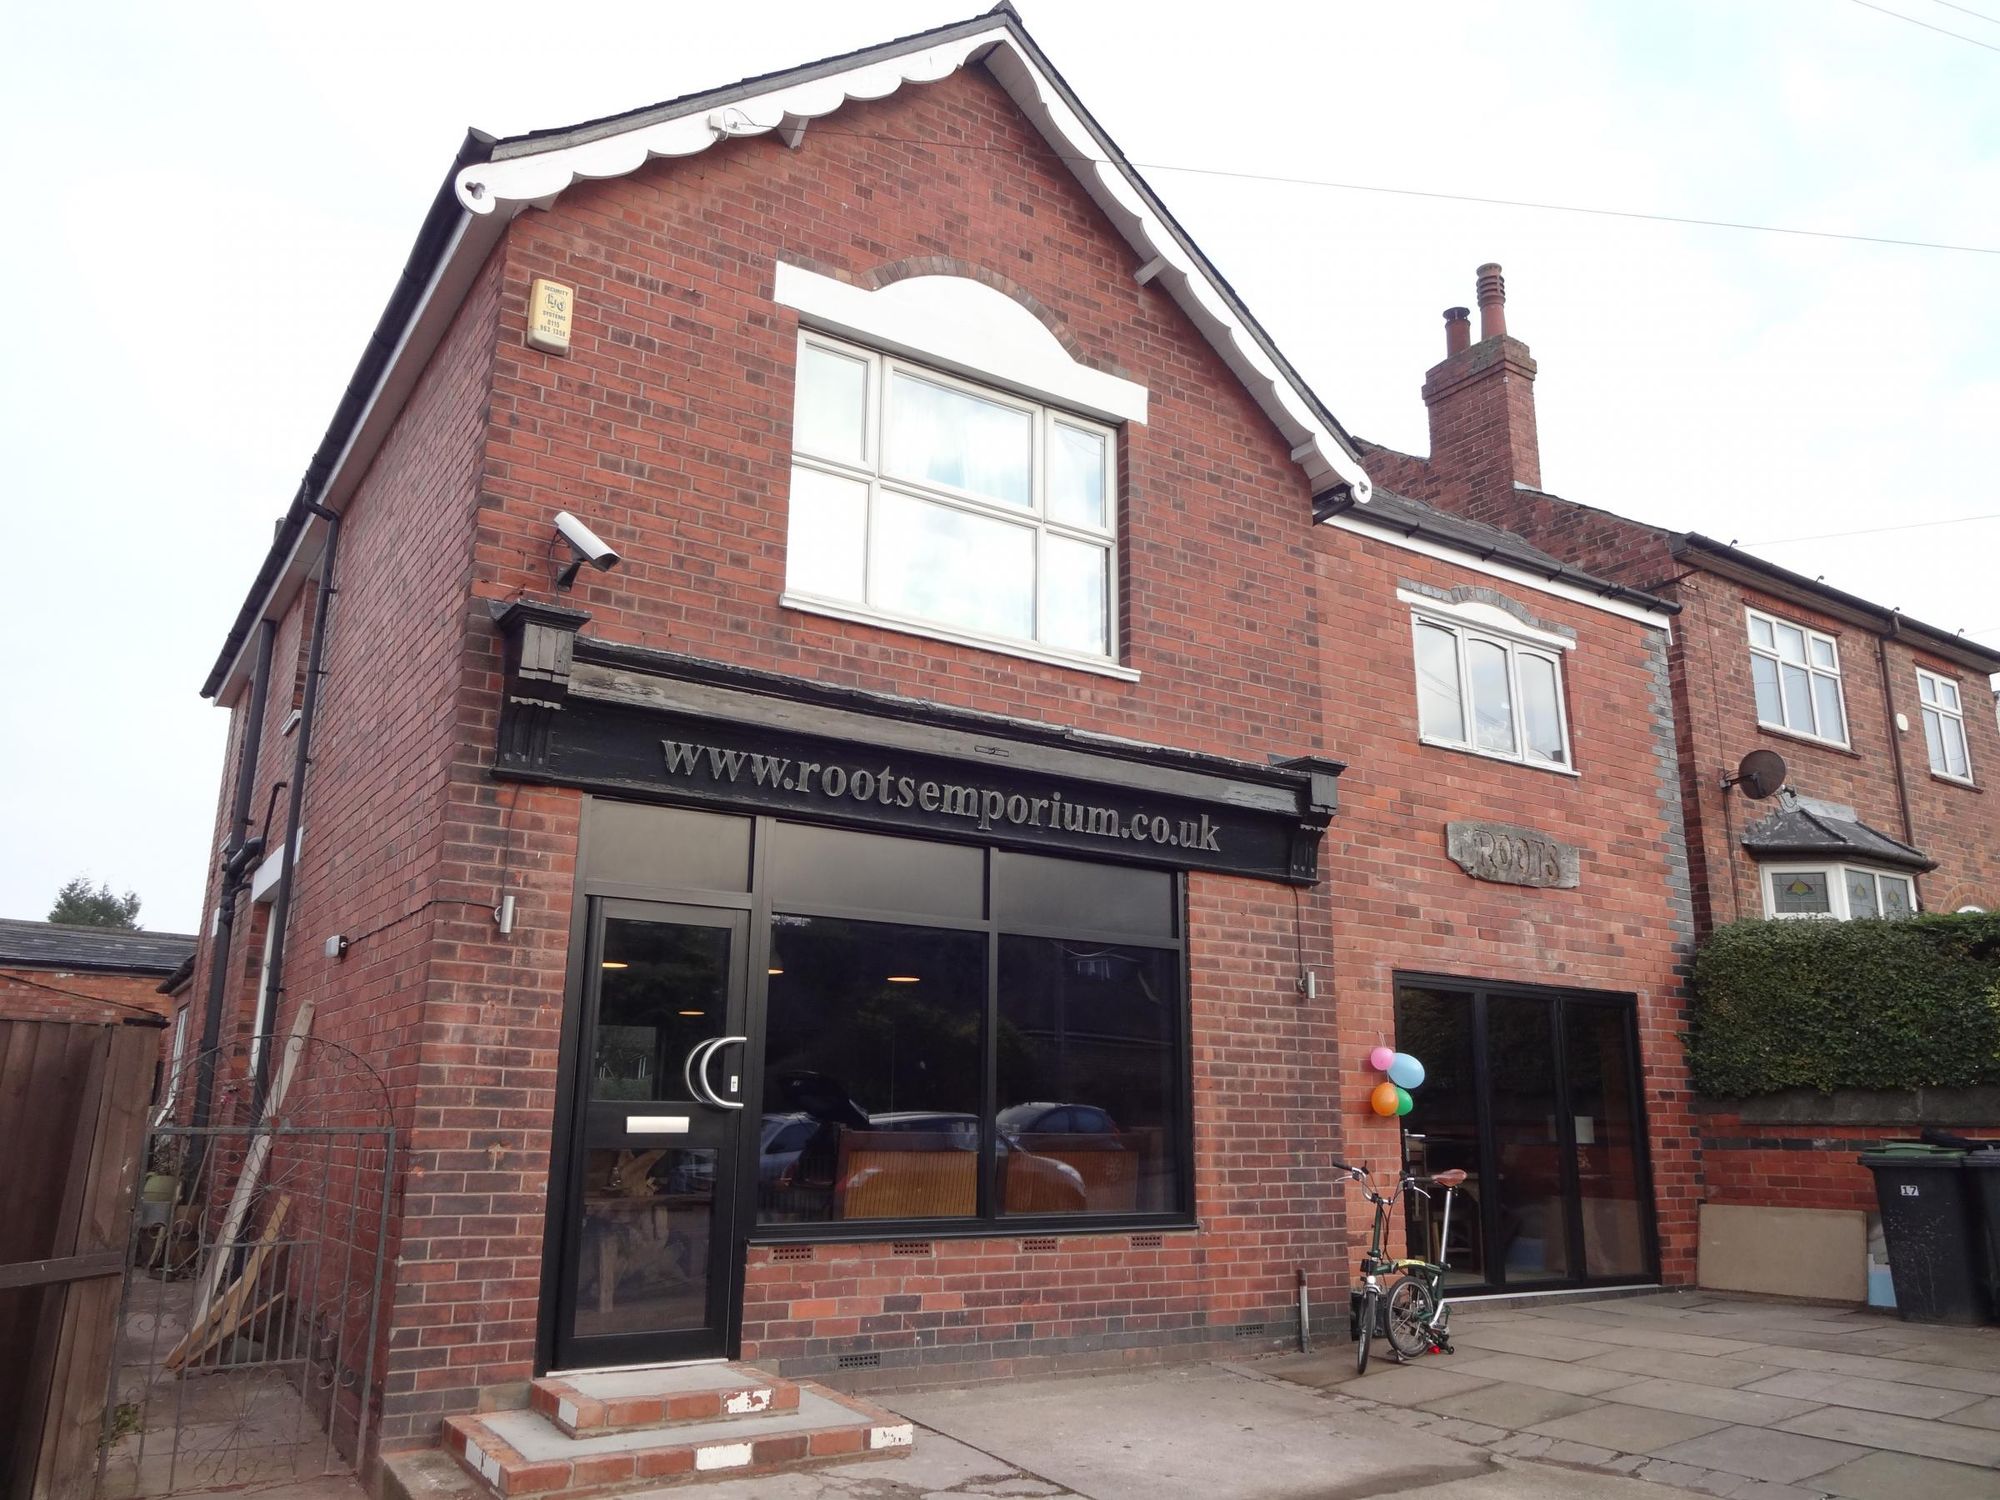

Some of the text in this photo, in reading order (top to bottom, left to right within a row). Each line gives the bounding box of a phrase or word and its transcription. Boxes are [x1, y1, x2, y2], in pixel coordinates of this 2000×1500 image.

[661, 740, 1221, 851] www.rootsemporium.co.uk
[1473, 829, 1561, 882] ROOTS
[1902, 1186, 1919, 1196] 17
